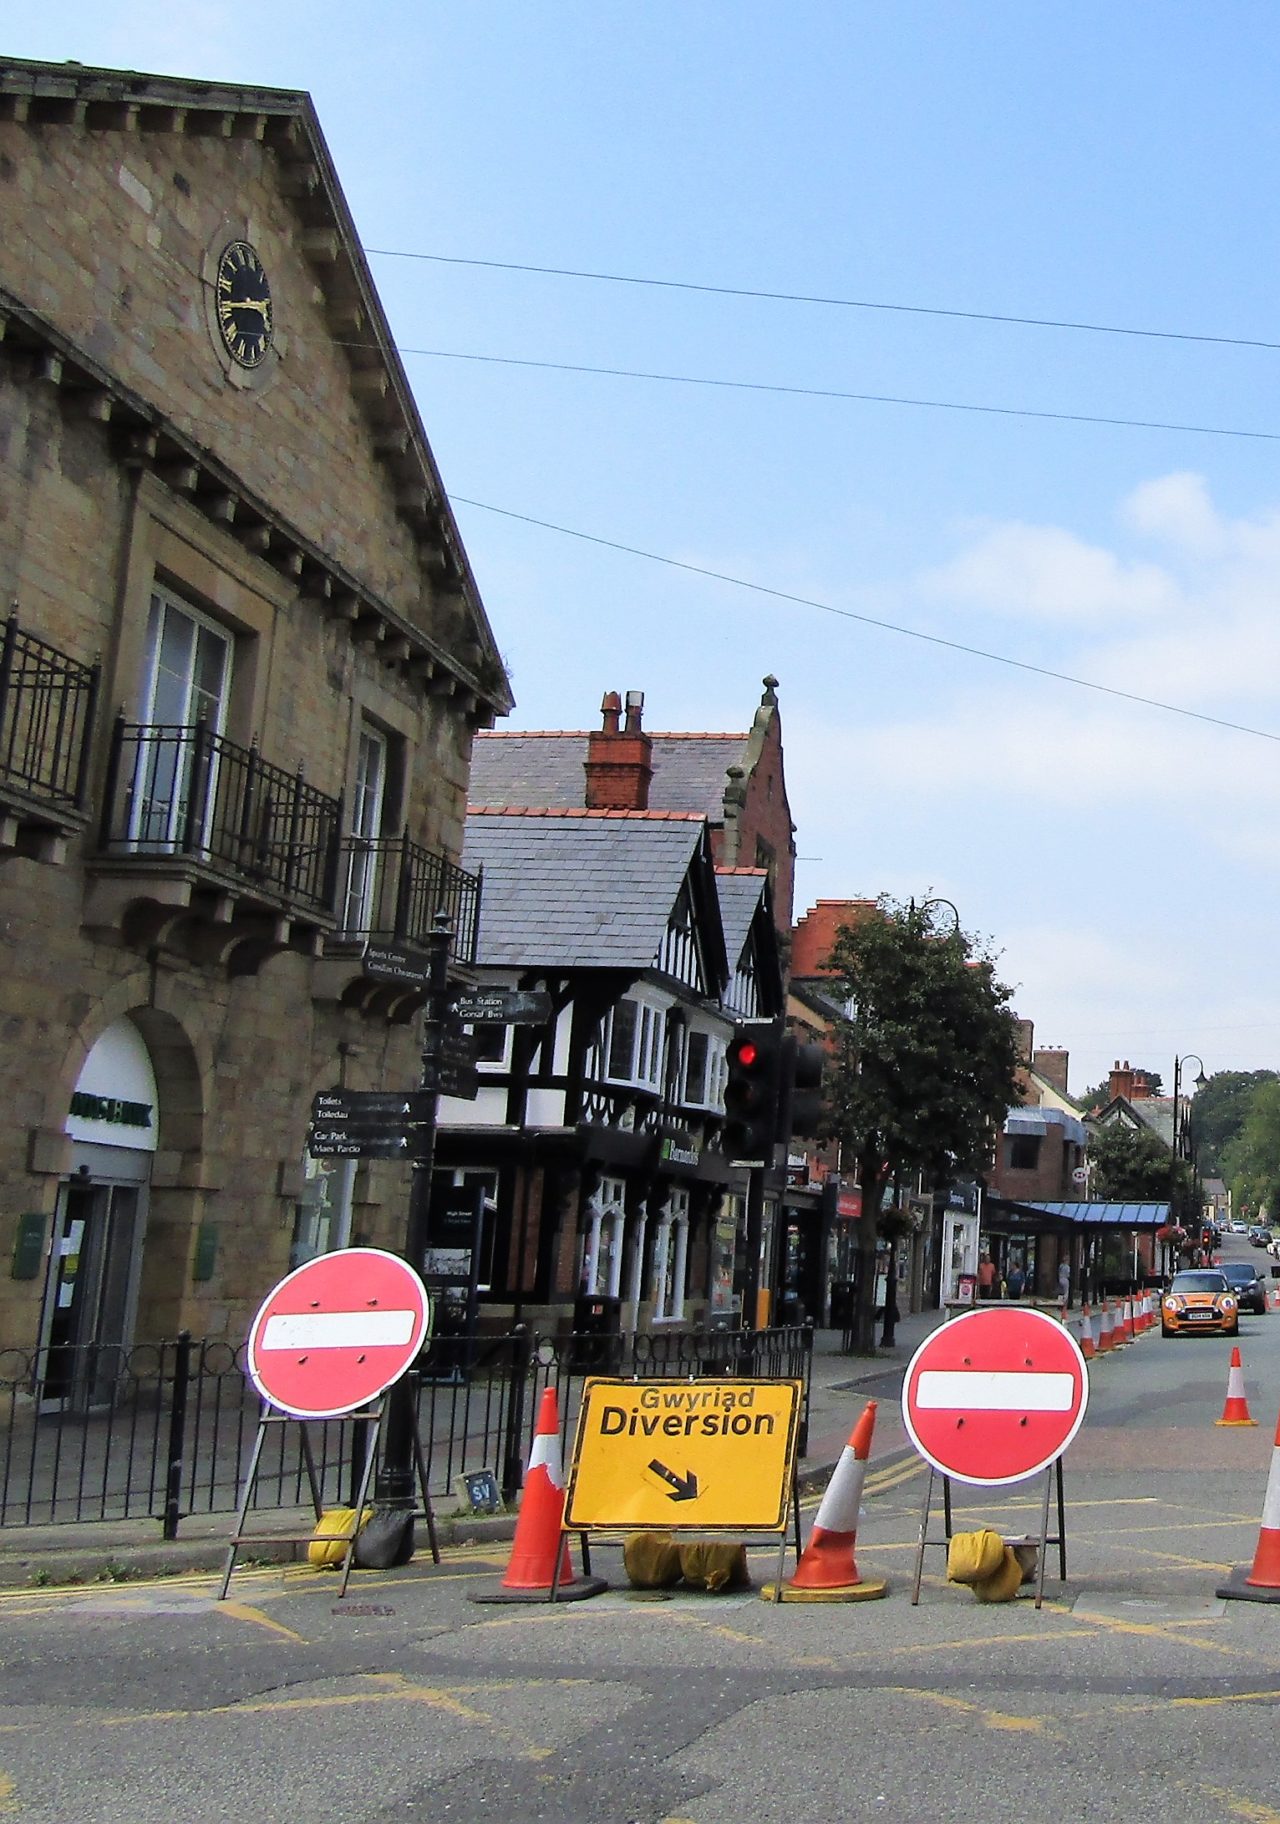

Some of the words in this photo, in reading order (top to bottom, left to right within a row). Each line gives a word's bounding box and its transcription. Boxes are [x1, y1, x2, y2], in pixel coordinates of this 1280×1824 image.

[460, 997, 473, 1005] Bus
[477, 997, 503, 1005] Station
[318, 1097, 342, 1105] Toilets
[314, 1131, 328, 1140] Car
[330, 1131, 347, 1140] Park
[314, 1144, 335, 1153] Maes
[640, 1387, 756, 1413] Gwyriad
[600, 1406, 775, 1436] Diversion
[473, 1484, 490, 1500] SV
